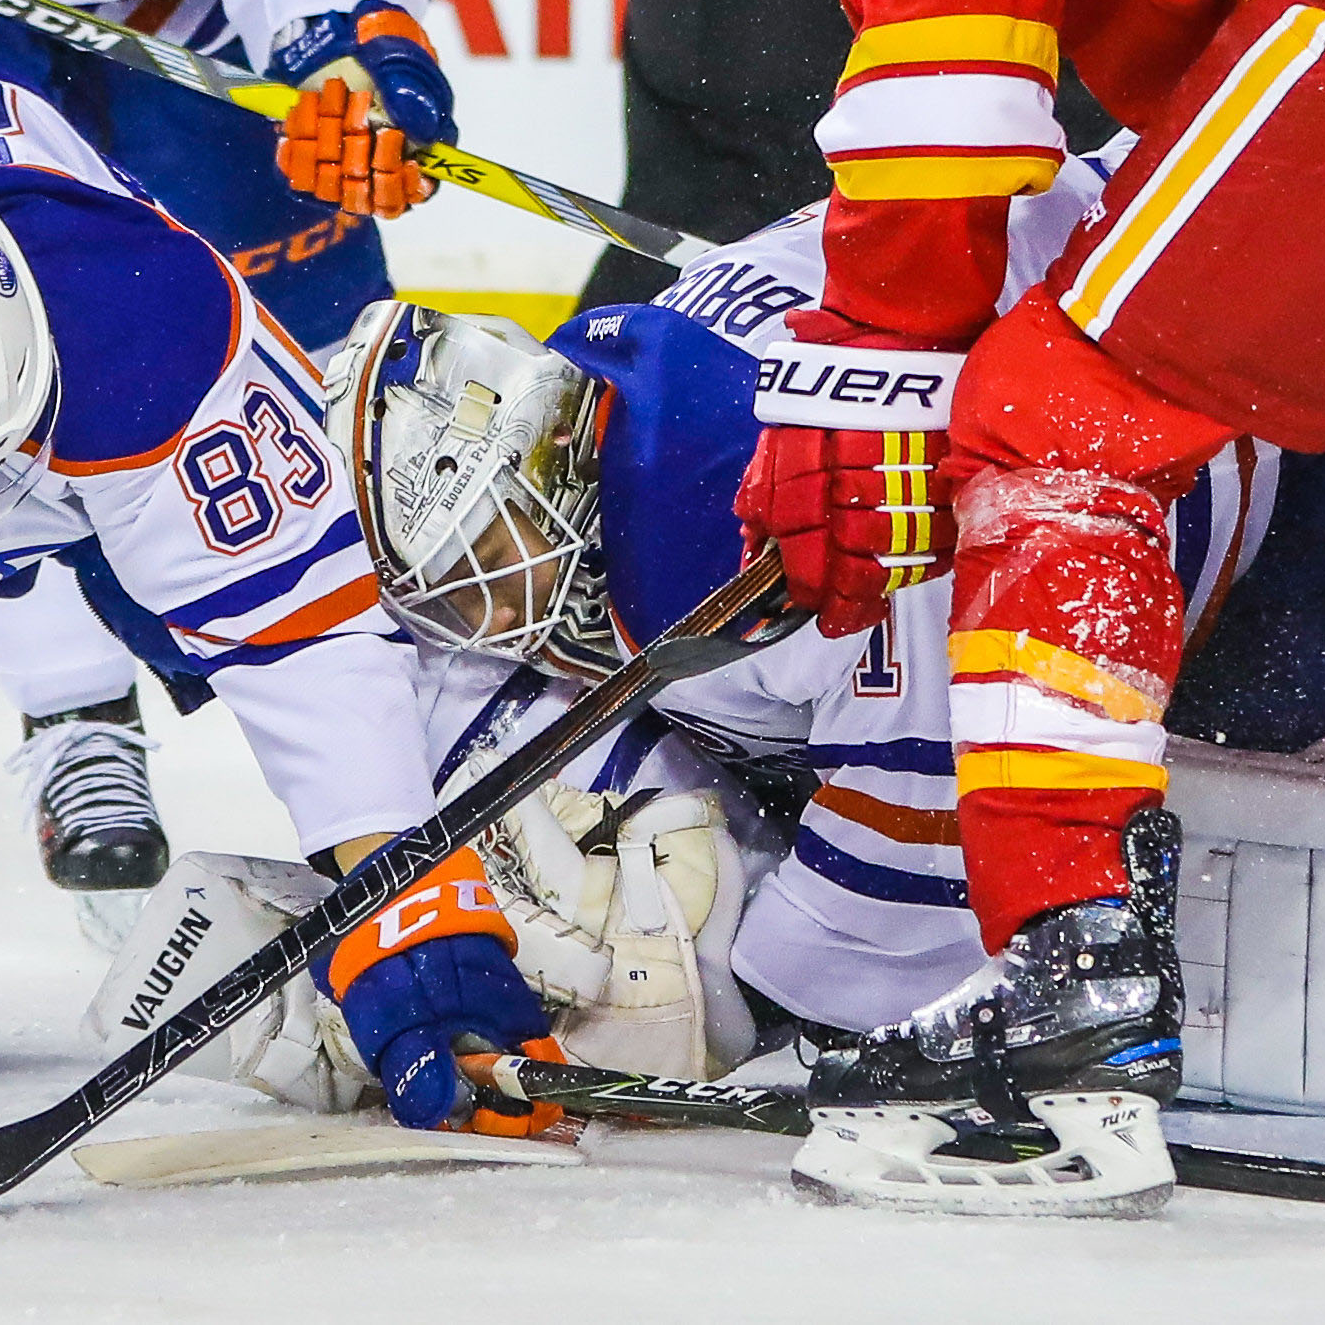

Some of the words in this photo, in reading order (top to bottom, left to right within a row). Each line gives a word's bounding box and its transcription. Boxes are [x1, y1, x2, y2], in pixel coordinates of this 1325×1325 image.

[755, 358, 944, 408] AUER
[470, 422, 502, 463] PLACE
[173, 380, 333, 557] 83
[372, 879, 501, 951] CC
[77, 812, 452, 1127] EASTON
[120, 907, 213, 1032] VAUGHN
[628, 970, 648, 981] LB
[395, 1049, 436, 1097] CCM
[647, 1076, 768, 1104] CCM
